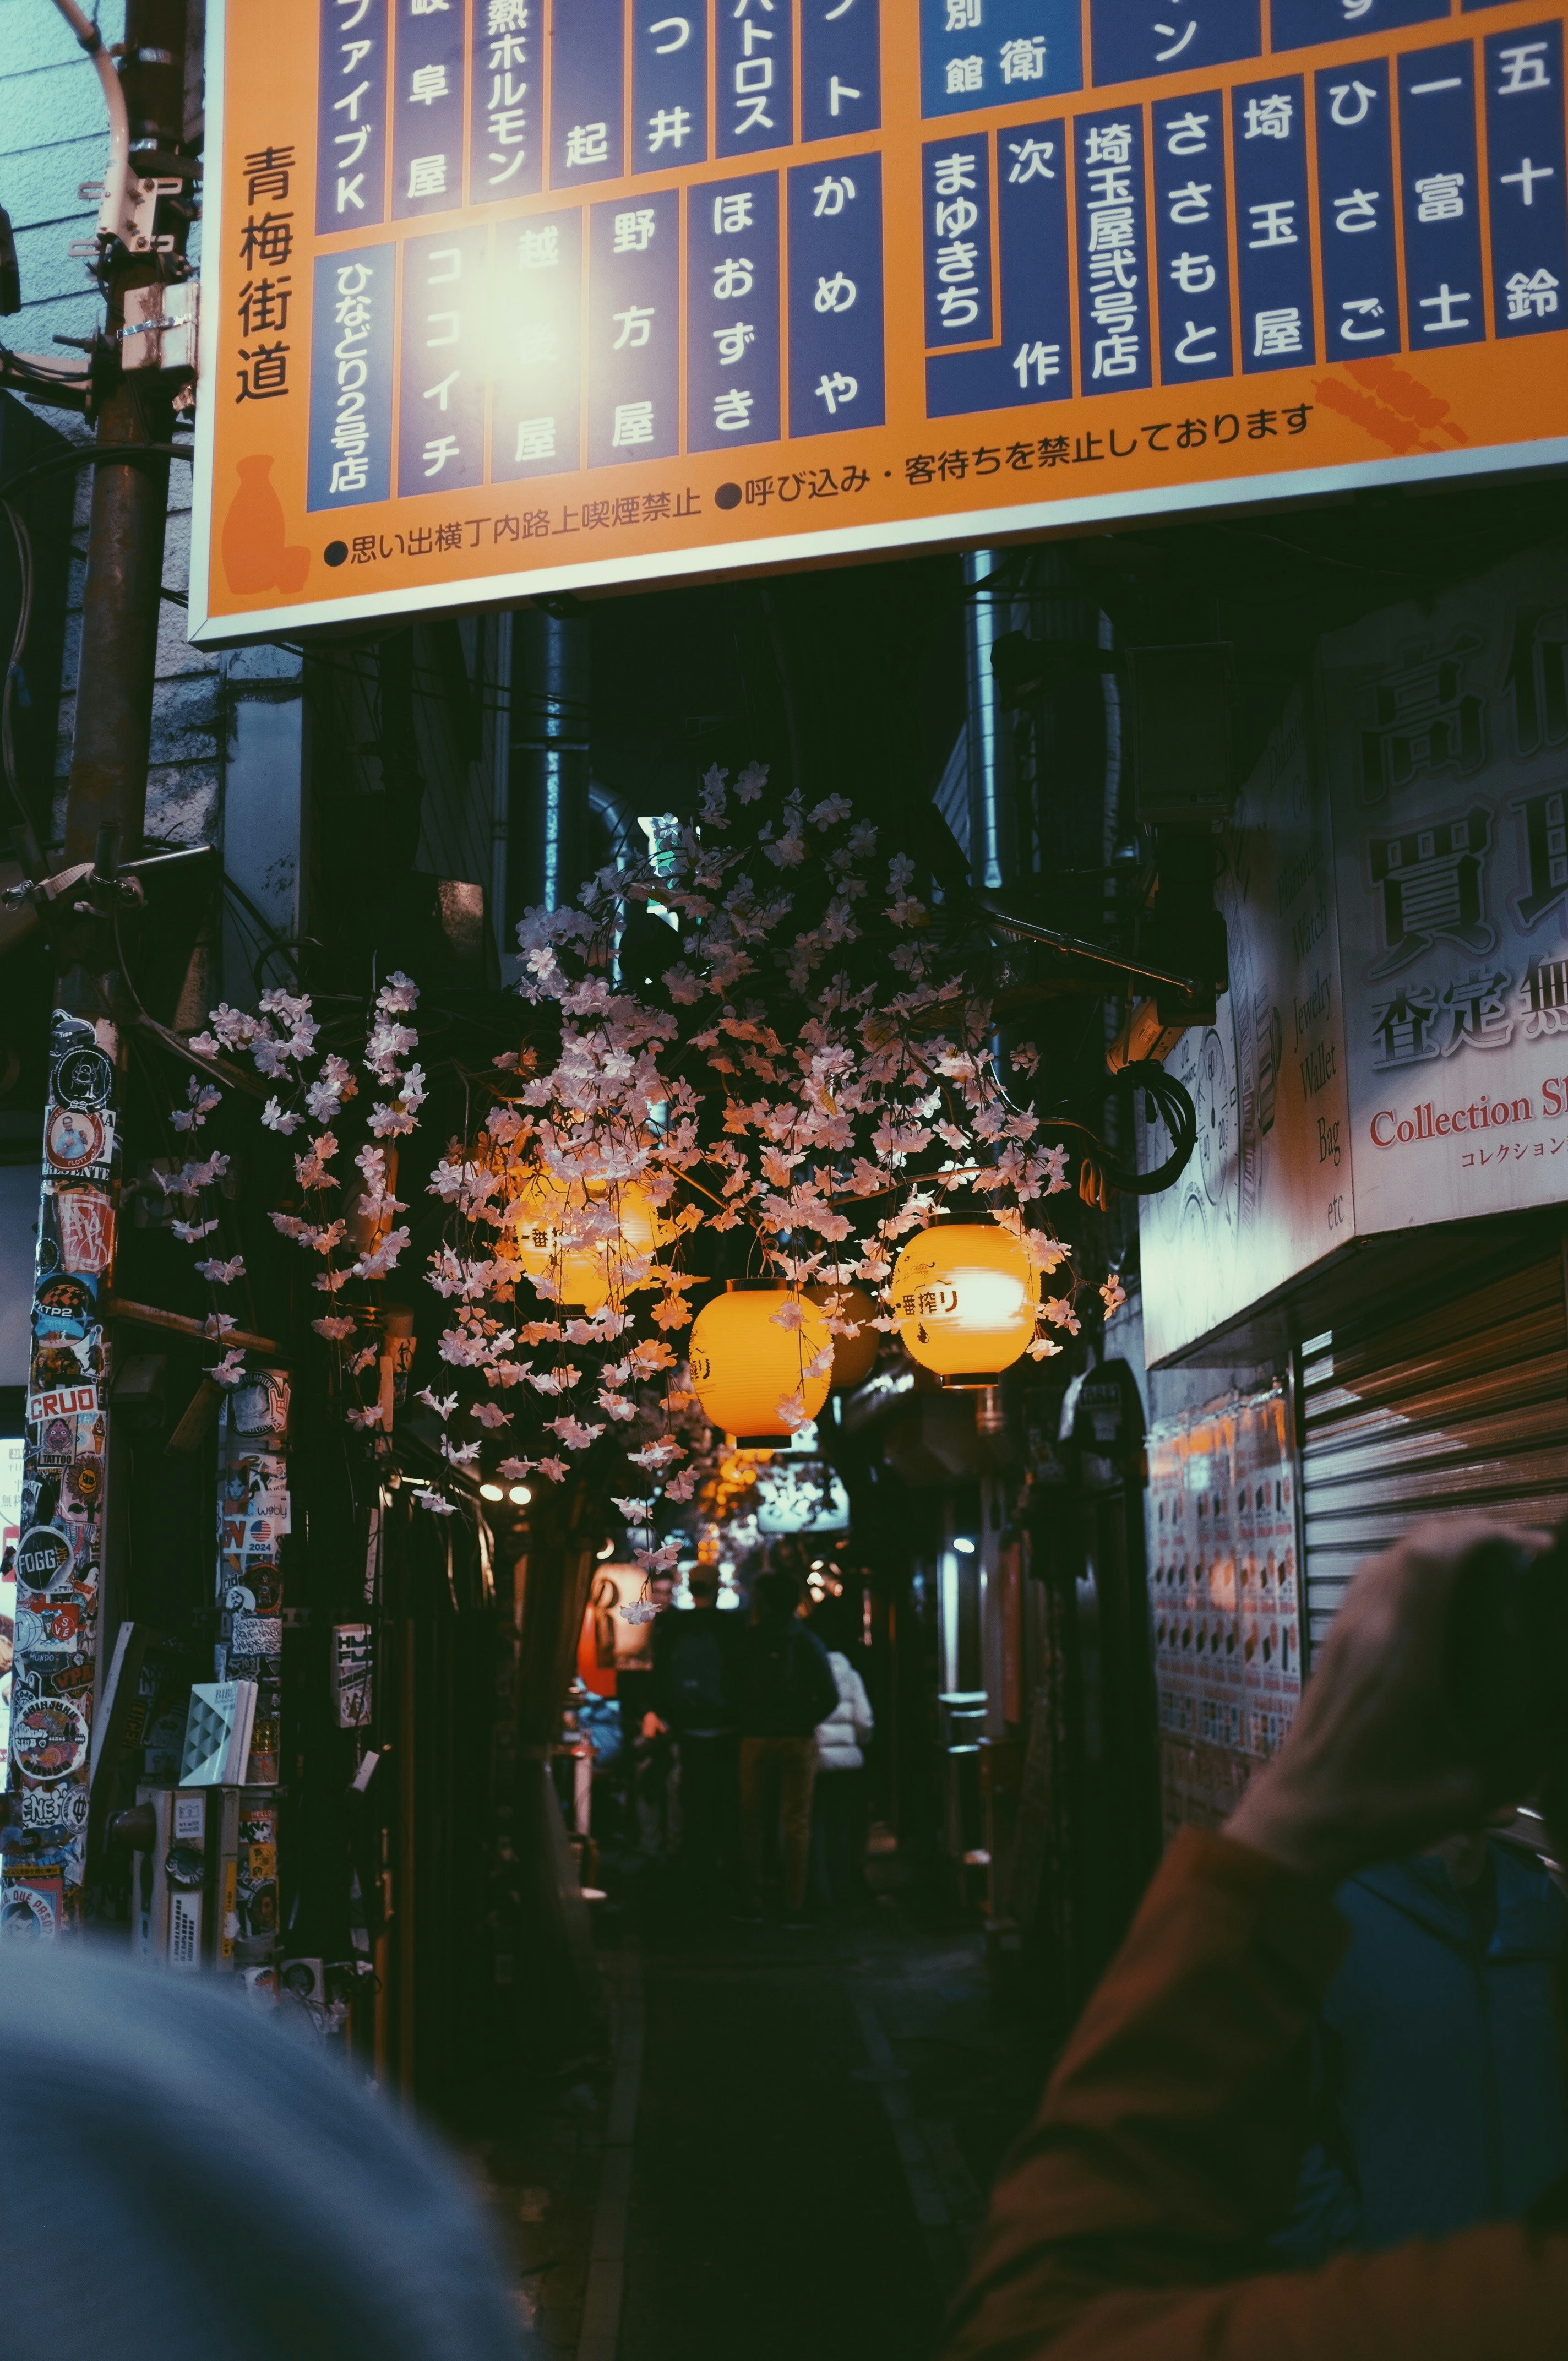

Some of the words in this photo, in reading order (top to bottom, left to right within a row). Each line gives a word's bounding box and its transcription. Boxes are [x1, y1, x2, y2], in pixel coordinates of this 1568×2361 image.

[333, 0, 373, 213] ファイブK
[945, 0, 984, 94] 別館
[235, 145, 296, 404] 青梅街道
[813, 176, 858, 414] かめや
[934, 153, 979, 327] まゆきち
[1085, 123, 1139, 379] 埼玉屋弐号店
[1166, 112, 1217, 365] ささもと
[1244, 94, 1303, 357] 埼玉屋
[1329, 80, 1385, 341] ひさご
[1411, 77, 1471, 332] 一富士
[1498, 42, 1560, 320] 五十鈴
[330, 263, 373, 493] ひなどり2号店
[422, 248, 460, 478] ココイチ
[612, 208, 655, 447] 野方屋
[712, 192, 755, 431] ほおずき
[1292, 889, 1328, 965] Watch
[1293, 969, 1331, 1053] Jewelry
[1299, 1040, 1337, 1103] Wallet
[1316, 1116, 1341, 1167] Bag
[1370, 1095, 1532, 1148] Collection
[1462, 1136, 1568, 1168] コレクション
[1327, 1193, 1344, 1231] etc
[43, 1455, 72, 1464] TATTOO
